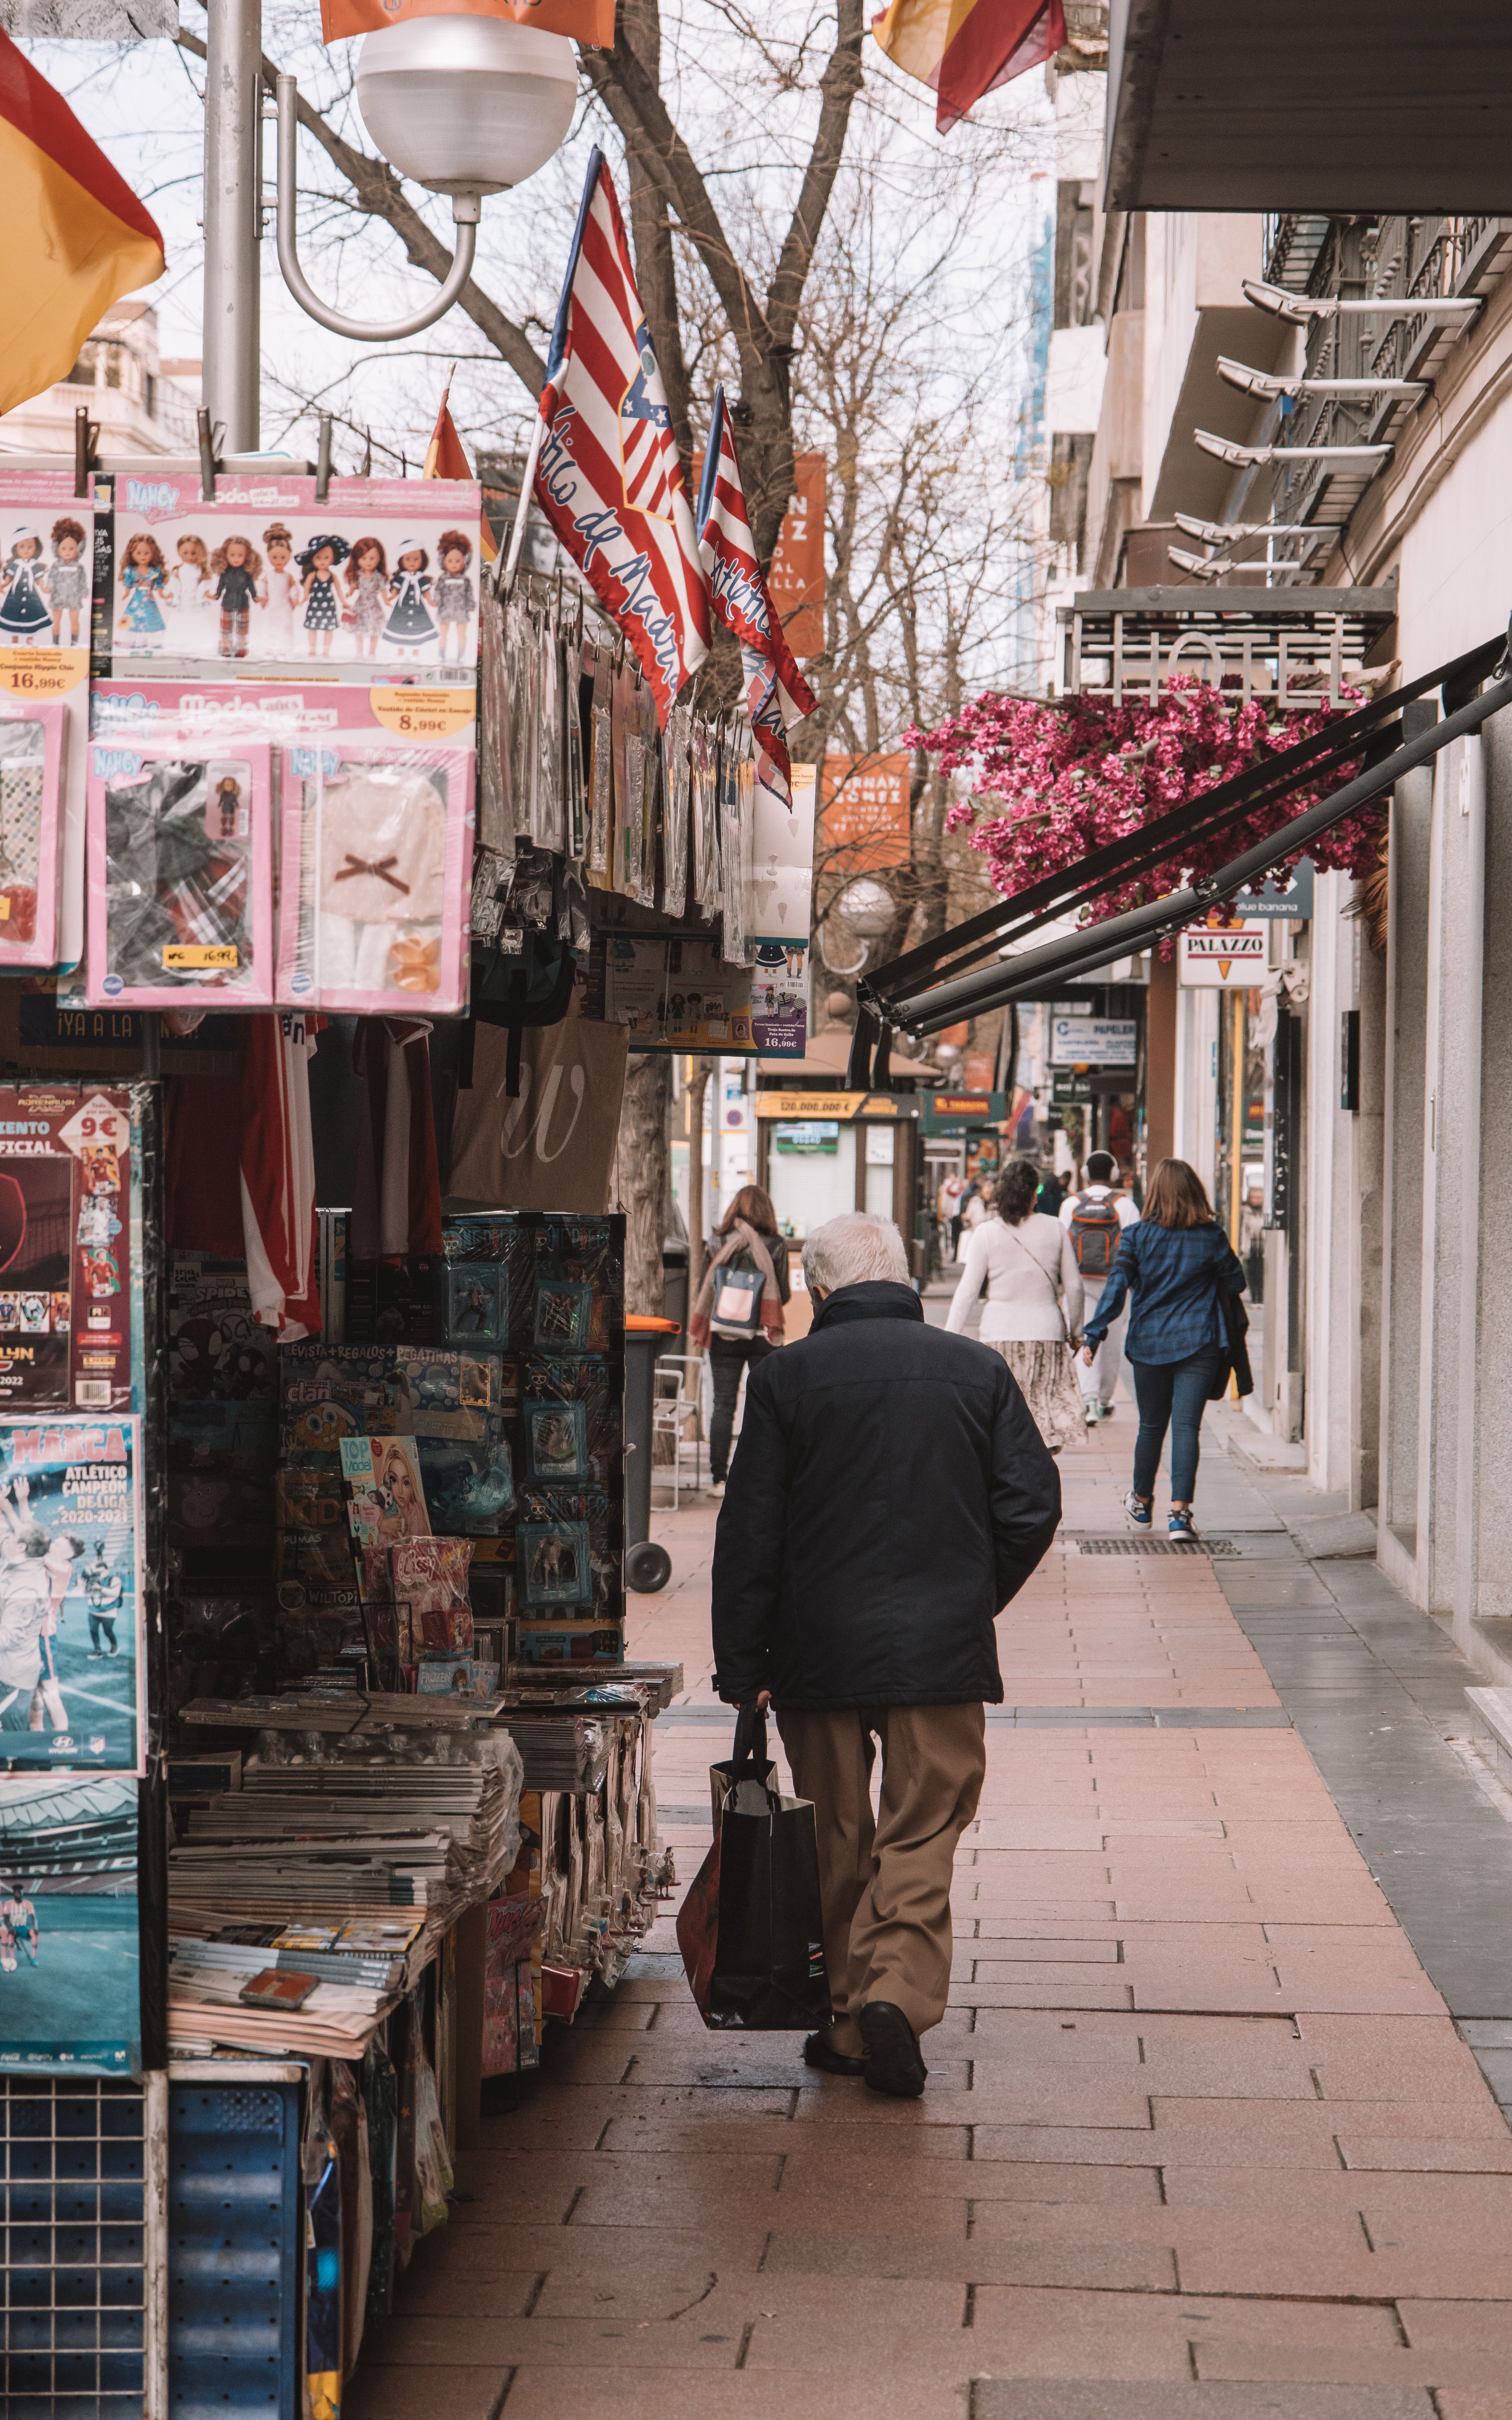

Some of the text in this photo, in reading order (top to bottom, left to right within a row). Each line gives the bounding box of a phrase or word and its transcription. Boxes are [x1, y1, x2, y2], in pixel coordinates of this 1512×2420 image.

[126, 478, 180, 514] NANCY
[573, 507, 623, 572] de
[1113, 631, 1369, 709] HOTEL
[11, 672, 66, 690] 16,99€
[400, 715, 447, 732] 8,99€
[93, 746, 142, 780] NANCY
[1259, 902, 1298, 911] banana
[1188, 938, 1263, 951] PALAZZO
[58, 1013, 85, 1036] ¡YA
[93, 1013, 104, 1037] A
[112, 1014, 132, 1037] LA
[765, 1037, 797, 1048] 16,99€
[285, 1343, 328, 1357] REVISTA
[338, 1345, 385, 1360] REGALOS
[397, 1347, 459, 1365] PEGATINAS
[286, 1381, 330, 1403] clan
[12, 1428, 127, 1462] MARCA
[343, 1440, 369, 1459] TOP
[65, 1465, 127, 1481] ATLÉTICO
[345, 1461, 371, 1473] Model
[62, 1478, 127, 1495] CAMPEÓN
[78, 1496, 127, 1509] DE LIGA
[61, 1509, 128, 1524] 2020-2021
[283, 1533, 322, 1546] PUMAS
[420, 1672, 451, 1685] FROZEN
